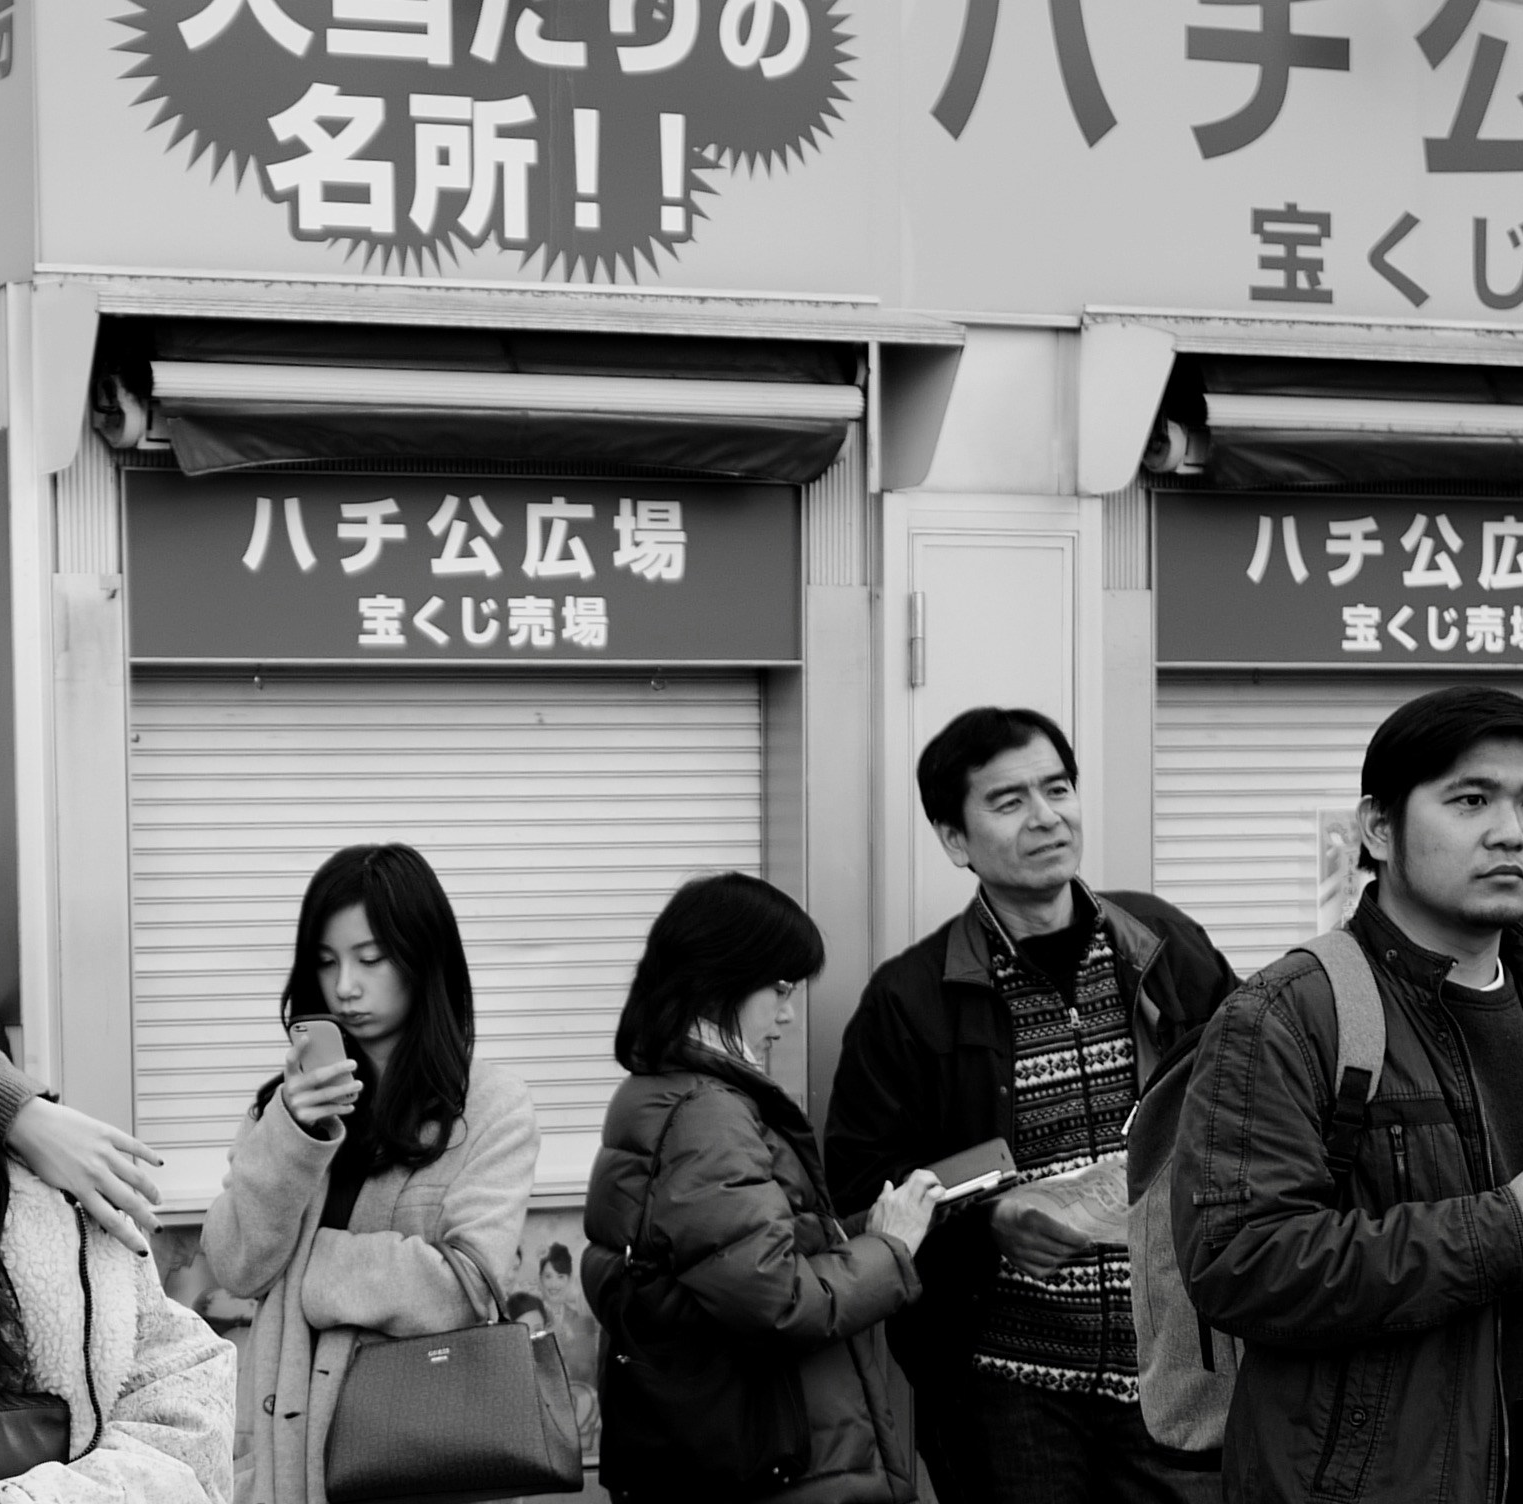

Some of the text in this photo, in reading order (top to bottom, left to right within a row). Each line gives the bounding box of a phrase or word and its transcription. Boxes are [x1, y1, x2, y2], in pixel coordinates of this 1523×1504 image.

[264, 81, 689, 241] 名所!!
[241, 494, 689, 583] ハチ公広場
[356, 593, 610, 650] 宝くじ売場
